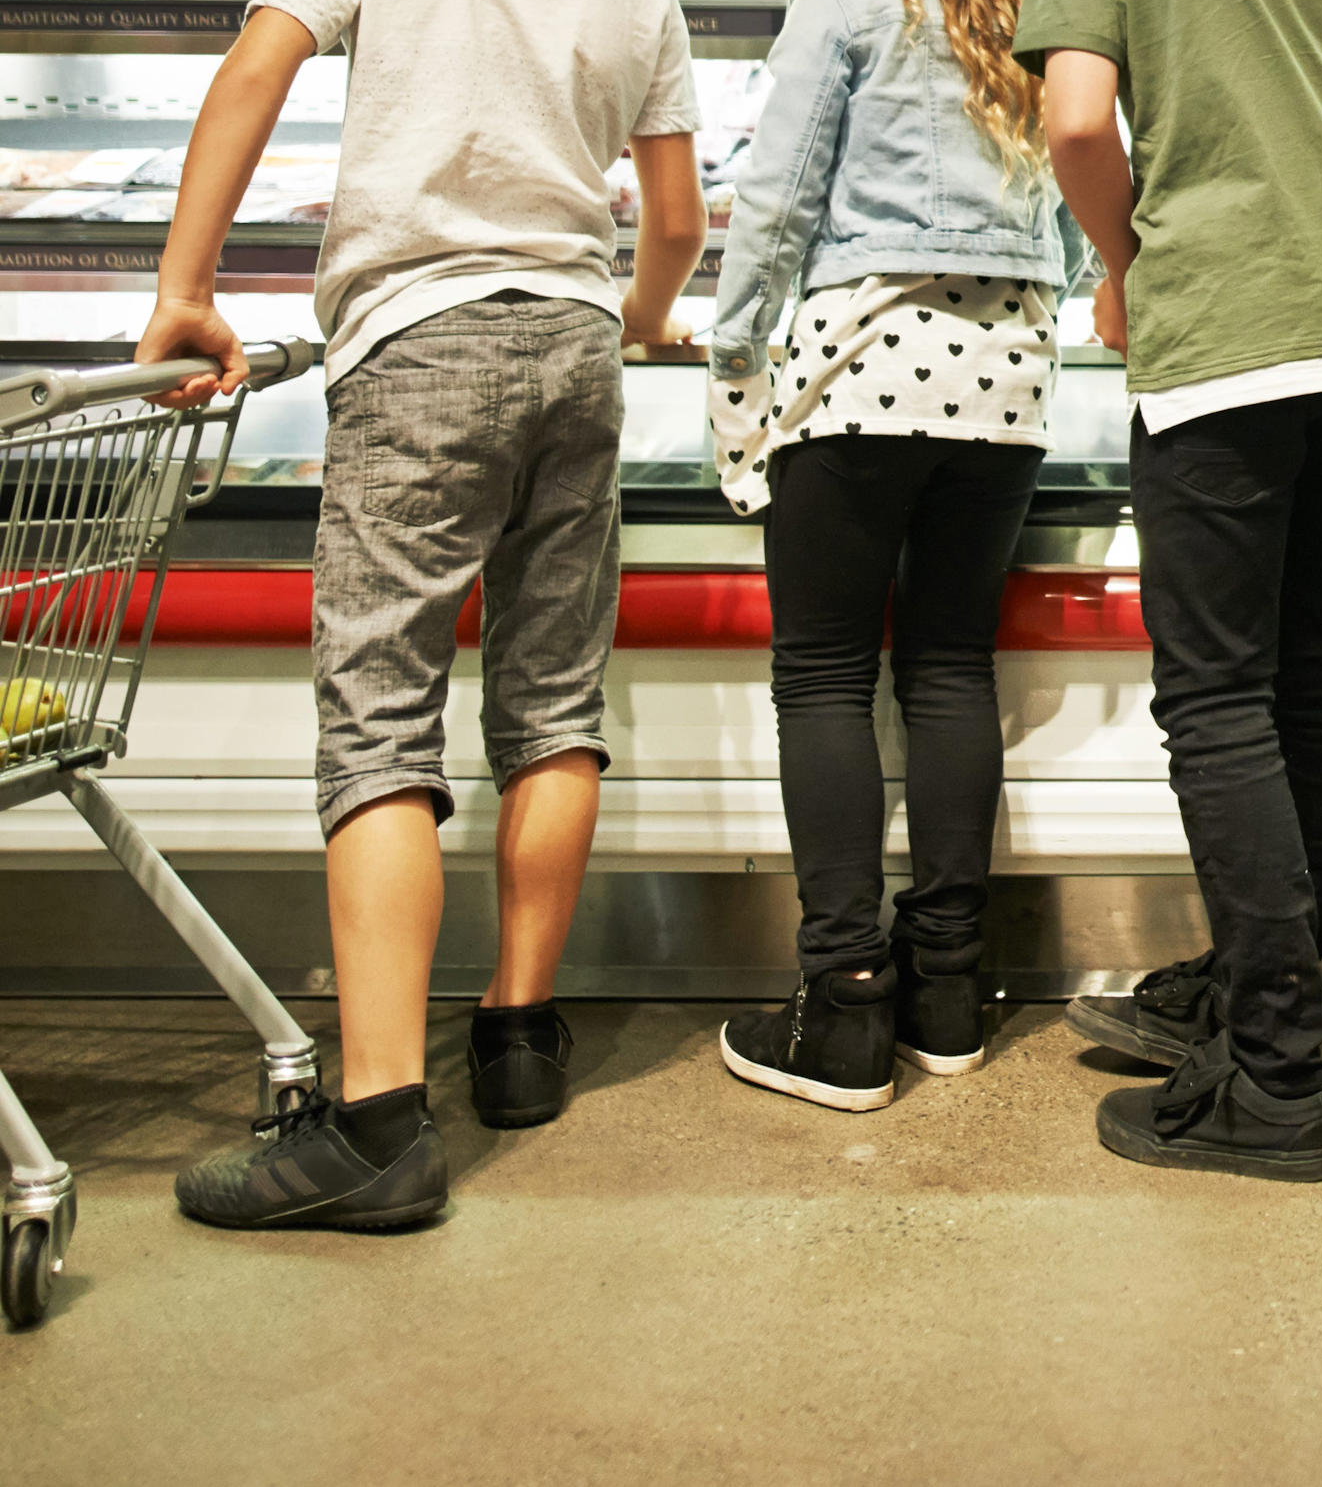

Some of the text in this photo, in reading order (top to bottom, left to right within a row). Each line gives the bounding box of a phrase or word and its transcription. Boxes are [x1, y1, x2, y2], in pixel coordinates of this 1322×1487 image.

[2, 12, 81, 26] RADITION
[86, 12, 106, 26] OF
[110, 9, 178, 29] QUALITY
[183, 11, 230, 26] SINCE
[687, 16, 719, 31] NCE
[0, 252, 74, 268] ADITION
[79, 252, 99, 268] OF
